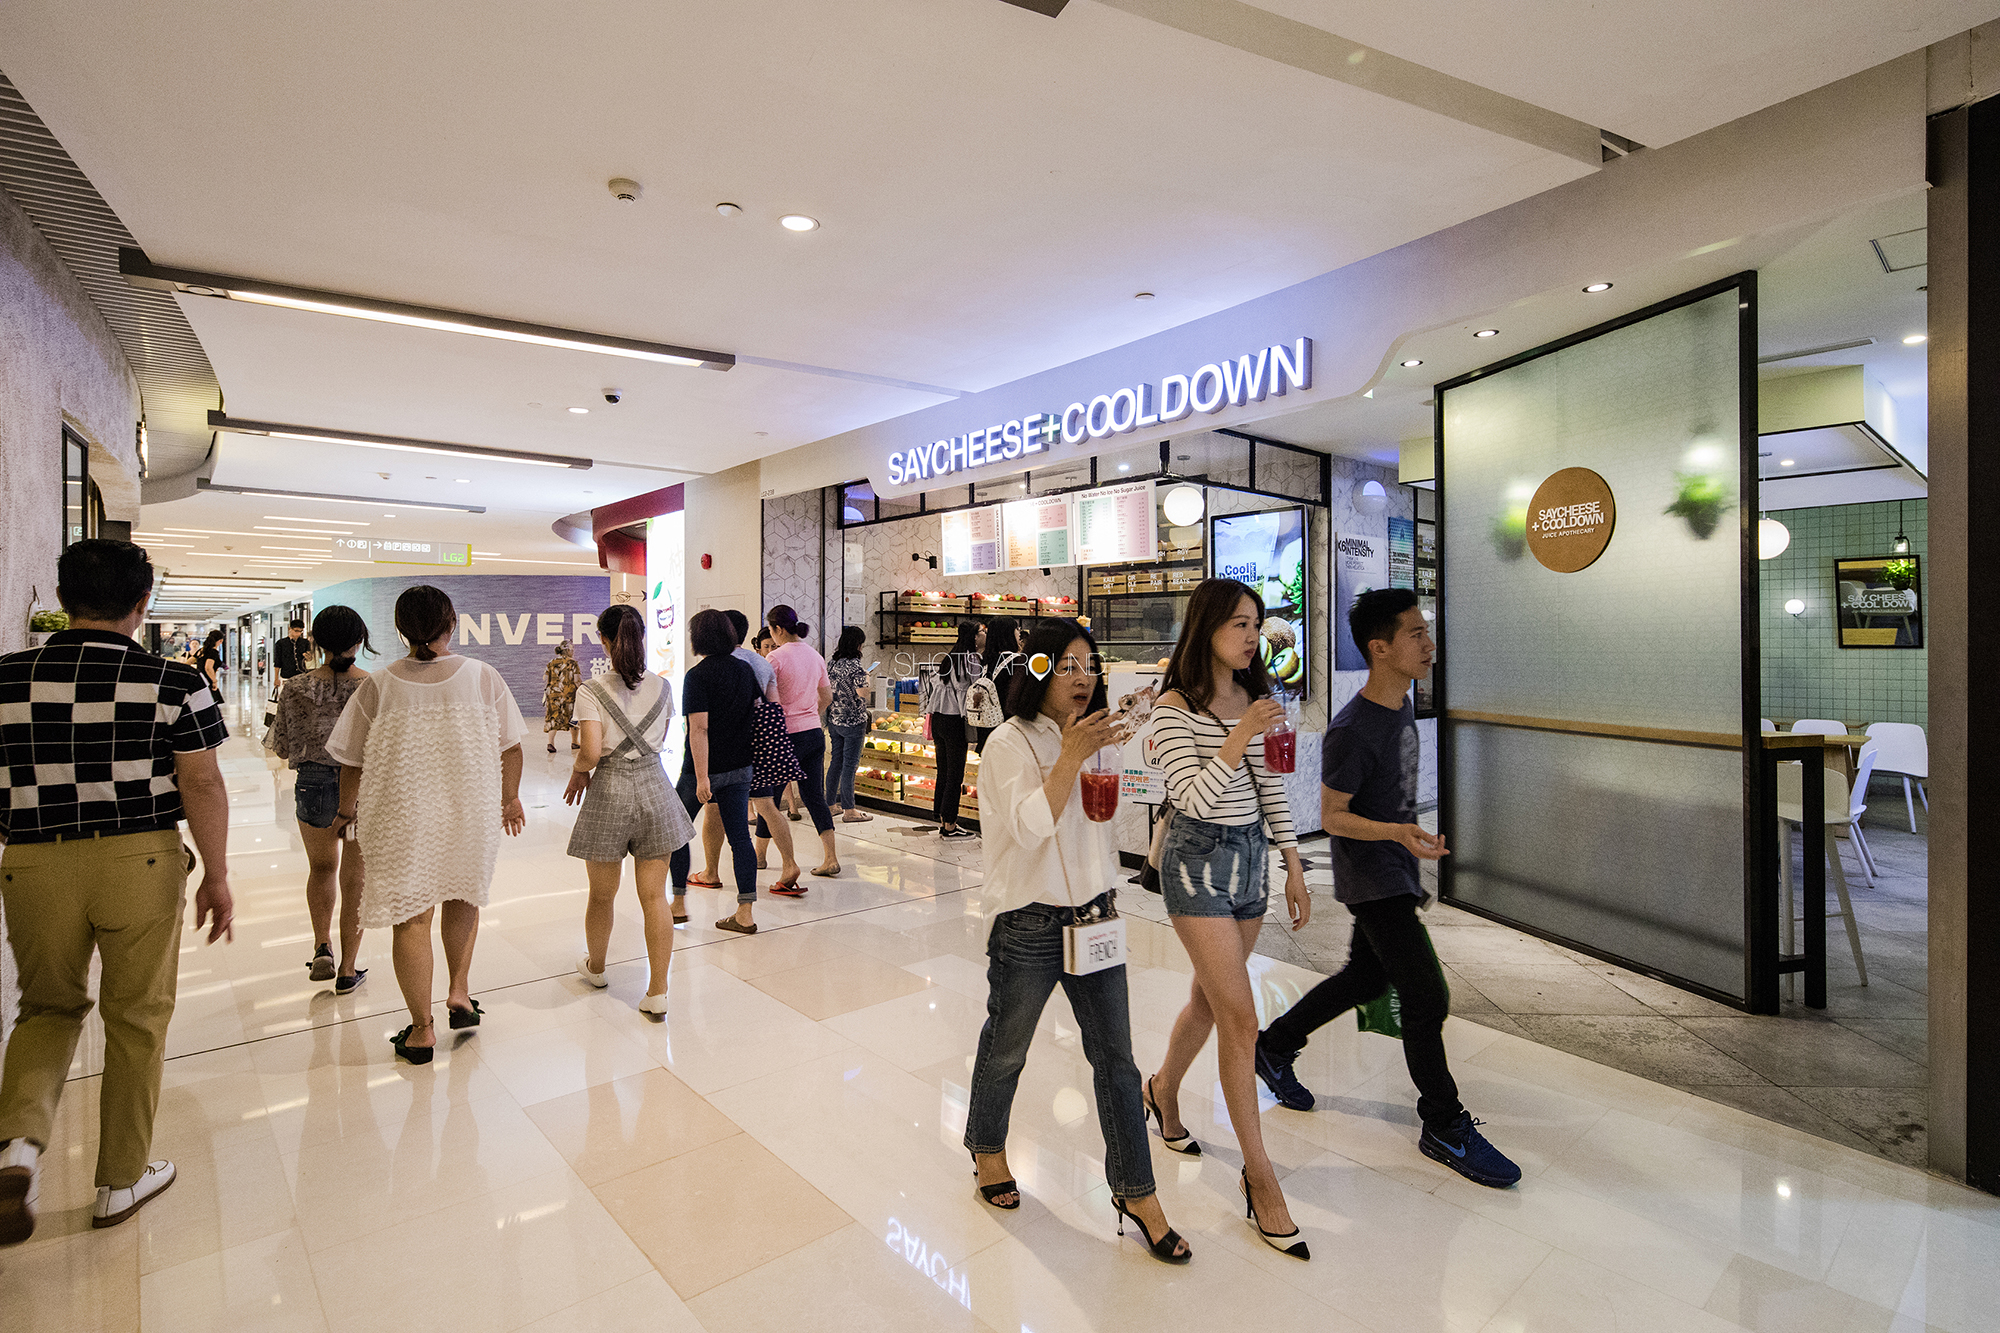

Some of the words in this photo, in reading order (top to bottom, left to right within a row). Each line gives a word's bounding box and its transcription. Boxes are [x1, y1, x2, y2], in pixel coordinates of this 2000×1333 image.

[1538, 501, 1601, 521] SAYCHEESE
[1541, 512, 1605, 532] COOLDOWN
[1542, 530, 1557, 539] JUICE
[1558, 527, 1595, 537] APOTHECARY
[1345, 537, 1369, 548] MINIMAL
[443, 552, 465, 563] LG2
[1345, 546, 1375, 558] INTENSITY
[1225, 562, 1249, 576] Cool
[1847, 594, 1867, 603] SAY
[1851, 601, 1880, 609] COOL
